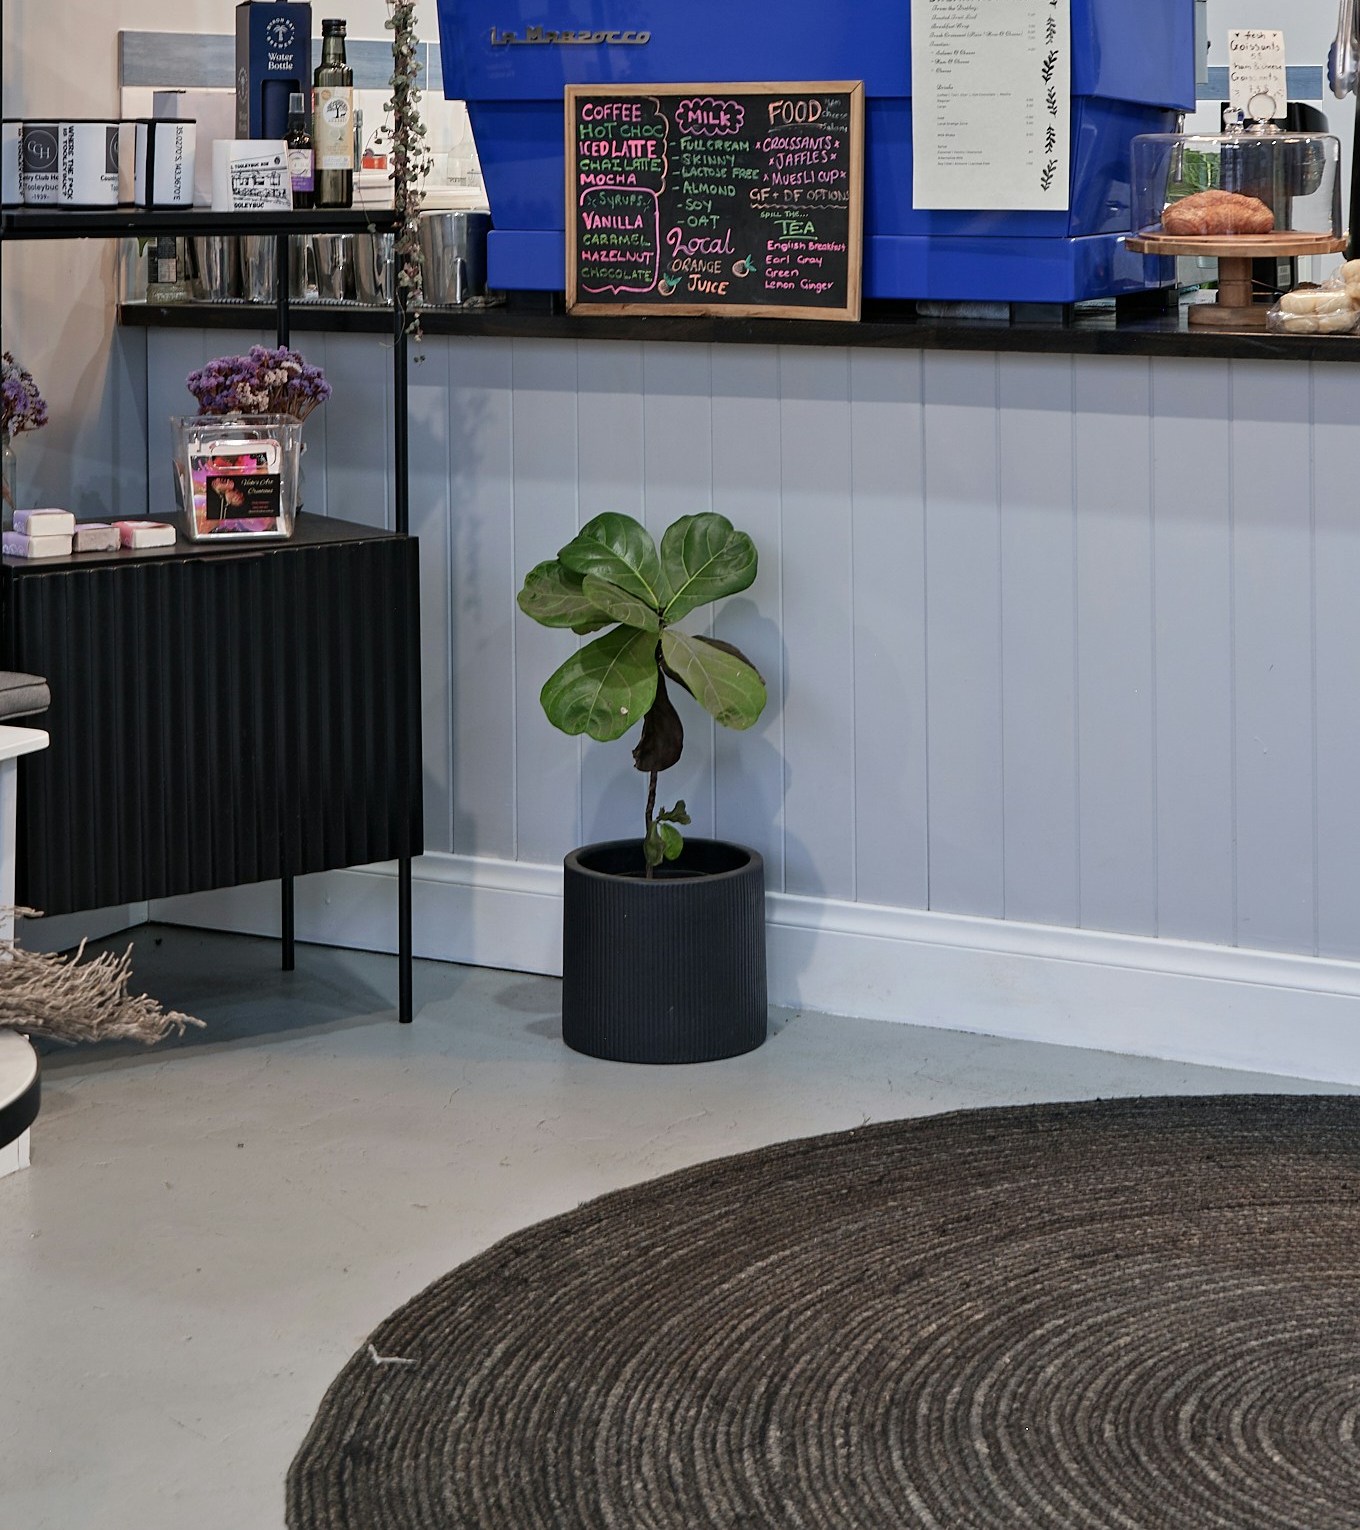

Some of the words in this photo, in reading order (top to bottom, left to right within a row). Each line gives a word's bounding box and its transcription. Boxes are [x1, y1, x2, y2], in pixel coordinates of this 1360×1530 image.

[268, 52, 293, 61] Water
[268, 61, 293, 70] Bottle
[582, 103, 641, 122] COFFEE
[688, 110, 731, 126] MILK
[768, 99, 822, 125] FOOD
[580, 122, 617, 139] HOT
[620, 124, 663, 138] CHOC
[579, 140, 609, 156] ICED
[612, 140, 657, 158] LATTE
[762, 135, 832, 152] CROISSANTS
[580, 158, 622, 171] CHAI
[624, 158, 661, 171] LATTE
[682, 153, 735, 167] SKINNY
[775, 150, 828, 170] JAFFLES
[580, 173, 637, 185] MOCHA
[681, 166, 727, 178] LACTOSE
[732, 167, 760, 179] FREE
[772, 170, 815, 186] MUESLI
[817, 170, 839, 184] CUP
[683, 180, 736, 197] ALMOND
[749, 187, 771, 202] GF
[784, 189, 804, 202] DF
[685, 198, 712, 213] SOY
[582, 211, 643, 230] VANILLA
[687, 215, 720, 229] OAT
[774, 220, 815, 235] TEA
[583, 233, 651, 247] CARAMEL
[666, 226, 735, 258] Local
[767, 240, 806, 252] English
[808, 241, 846, 253] Breakfast
[581, 250, 654, 265] HAZELNUT
[765, 255, 790, 265] Earl
[672, 257, 722, 274] ORANGE
[765, 268, 799, 278] Green
[581, 267, 652, 282] CHOCOLATE
[687, 273, 729, 295] JUICE
[765, 280, 795, 290] Lemon
[800, 278, 834, 294] Ginger
